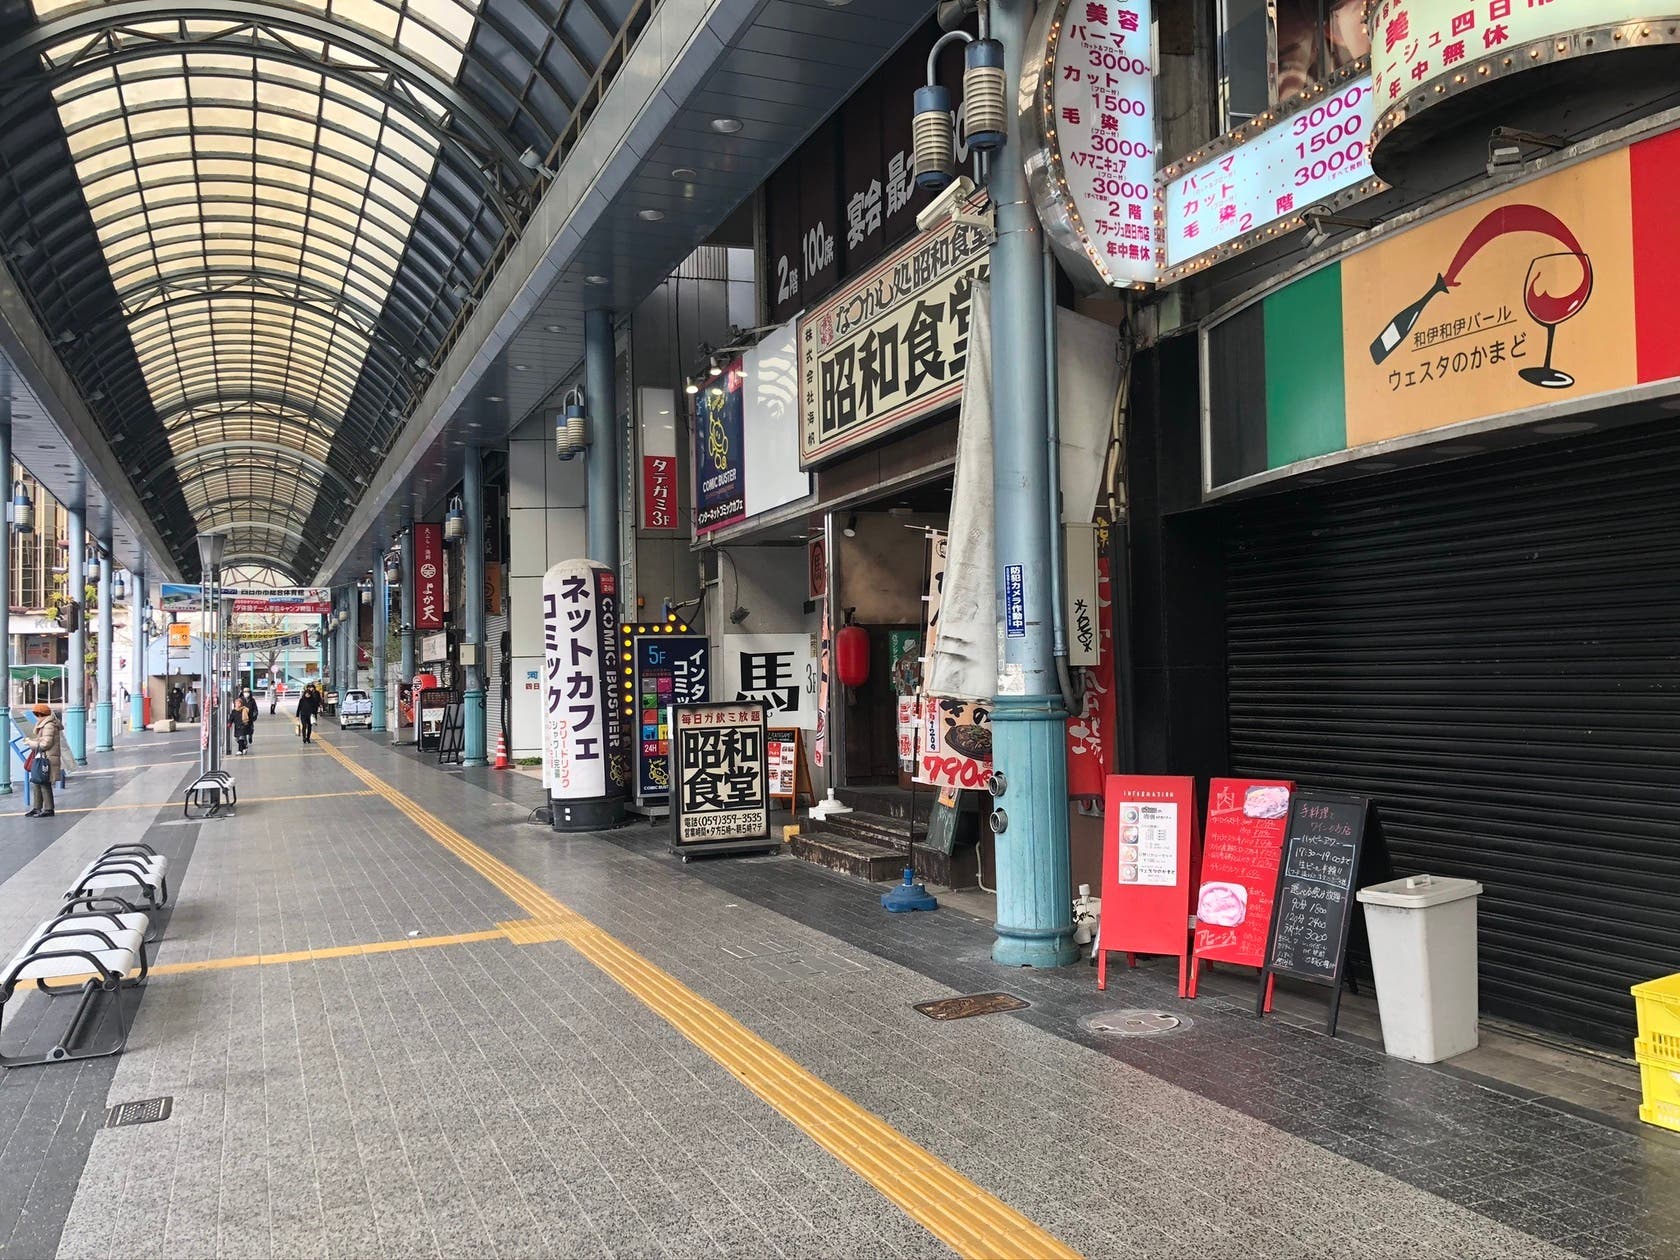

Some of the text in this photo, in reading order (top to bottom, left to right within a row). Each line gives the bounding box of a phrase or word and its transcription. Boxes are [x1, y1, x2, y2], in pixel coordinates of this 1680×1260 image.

[1086, 2, 1139, 32] 美容
[1063, 65, 1119, 88] カット
[1389, 24, 1509, 99] 年中無休
[1062, 107, 1119, 131] 毛染
[1092, 93, 1145, 117] 1500
[1295, 114, 1362, 160] 1500
[1070, 151, 1127, 173] ヘアマニキュア
[1093, 178, 1148, 200] 3000
[1183, 182, 1235, 218] カット
[847, 178, 881, 250] 宴会
[1108, 201, 1141, 221] 2階
[1106, 241, 1150, 261] 年中無休
[1413, 305, 1512, 350] 和伊和伊バール
[1388, 332, 1528, 392] ウェスタのかまど
[702, 477, 718, 493] COMIC
[718, 467, 737, 488] BUSTER
[652, 511, 670, 526] 3F
[1010, 566, 1023, 628] 防犯カメラ作動中
[602, 598, 616, 666] COMIC
[544, 594, 561, 713] コミック
[561, 575, 600, 761] ネットカフェ
[649, 646, 666, 664] 5F
[606, 671, 619, 747] BUSTER
[681, 710, 761, 726] 毎日ガ飲ミ放題
[644, 743, 657, 753] 24H
[684, 727, 759, 769] 昭和
[684, 766, 761, 812] 食堂
[1123, 790, 1175, 798] INFORMATION
